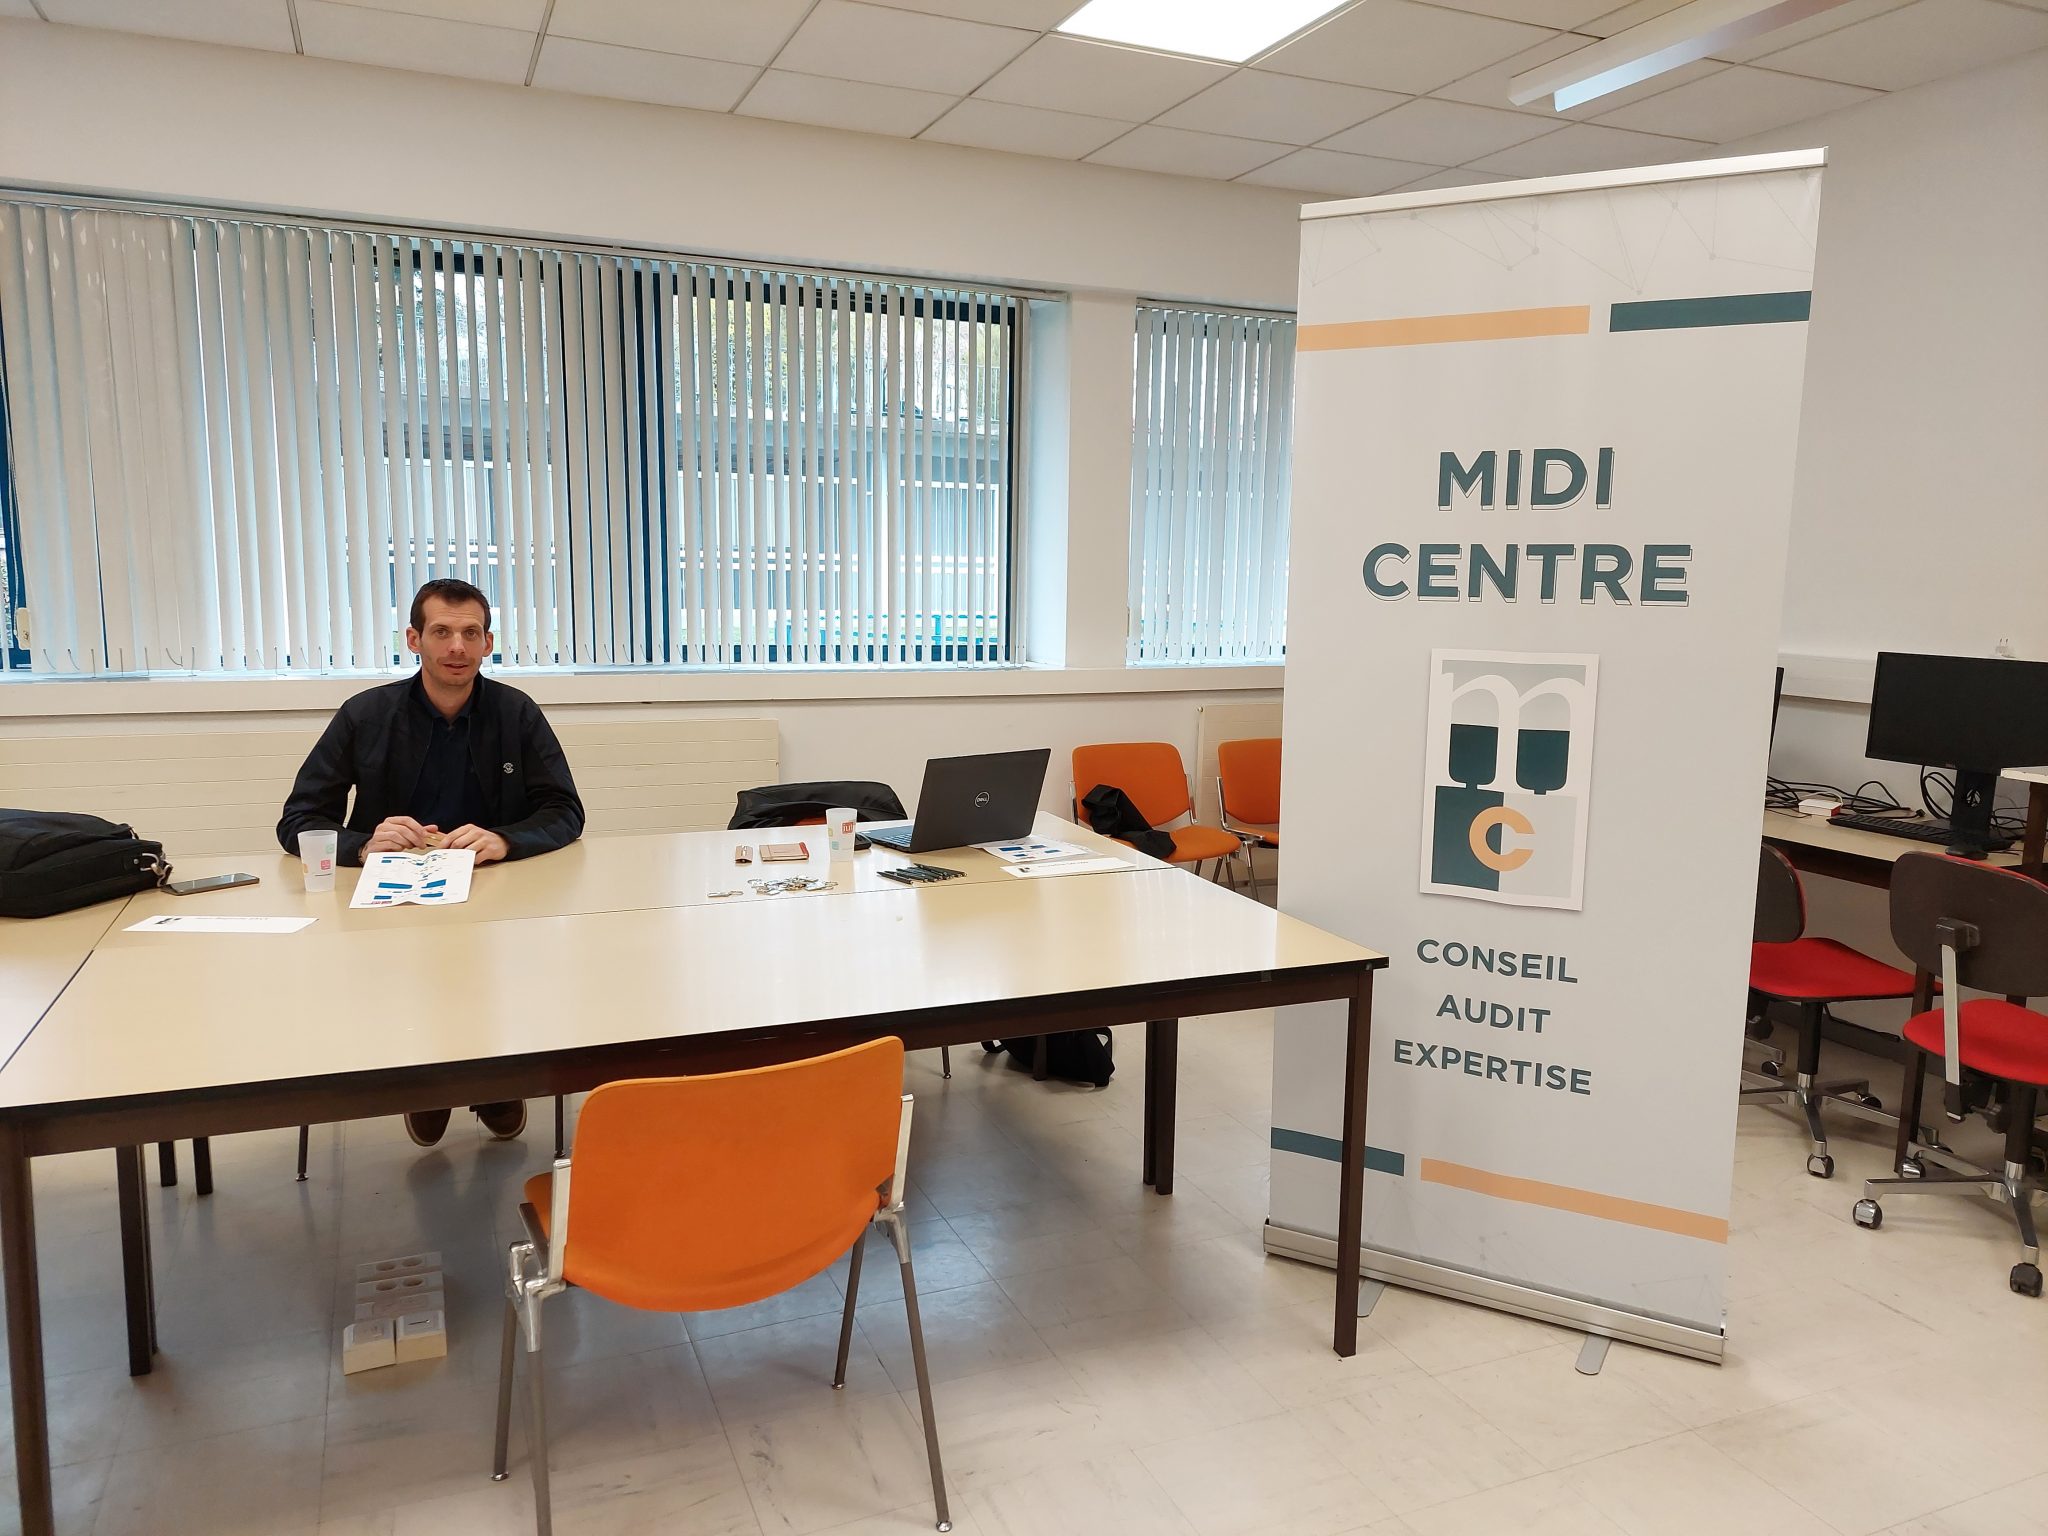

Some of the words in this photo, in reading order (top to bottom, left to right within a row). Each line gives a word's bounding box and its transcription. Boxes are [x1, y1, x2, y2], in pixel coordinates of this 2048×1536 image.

[1438, 447, 1615, 510] MIDI
[1362, 542, 1692, 606] CENTRE
[1417, 939, 1578, 983] CONSEIL
[1436, 994, 1551, 1033] AUDIT
[1394, 1039, 1592, 1095] EXPERTISE
